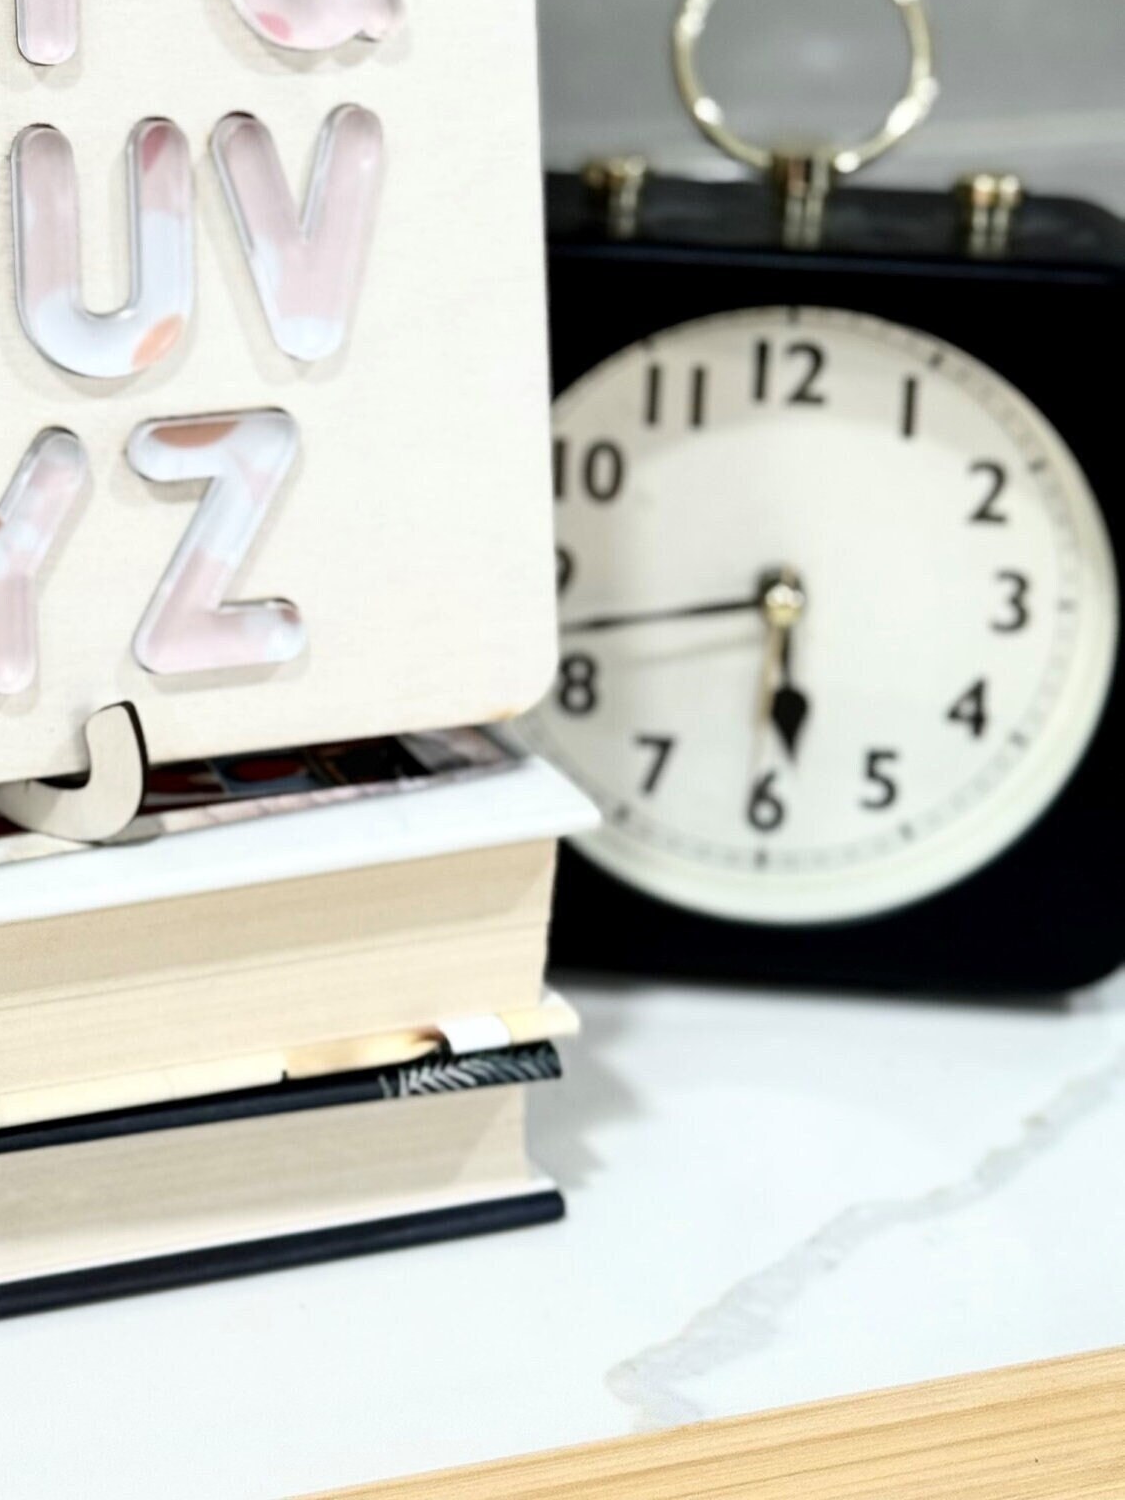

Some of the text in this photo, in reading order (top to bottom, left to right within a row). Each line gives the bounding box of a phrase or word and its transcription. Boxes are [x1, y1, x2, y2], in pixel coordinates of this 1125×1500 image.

[642, 363, 706, 428] 11
[753, 337, 827, 406] 12
[900, 376, 920, 439] 1
[552, 438, 625, 503] 10
[967, 460, 1009, 524] 2
[989, 571, 1032, 635] 3
[557, 652, 600, 719] 8
[944, 678, 989, 739] 4
[633, 735, 678, 797] 7
[859, 749, 900, 811] 5
[745, 770, 786, 833] 6
